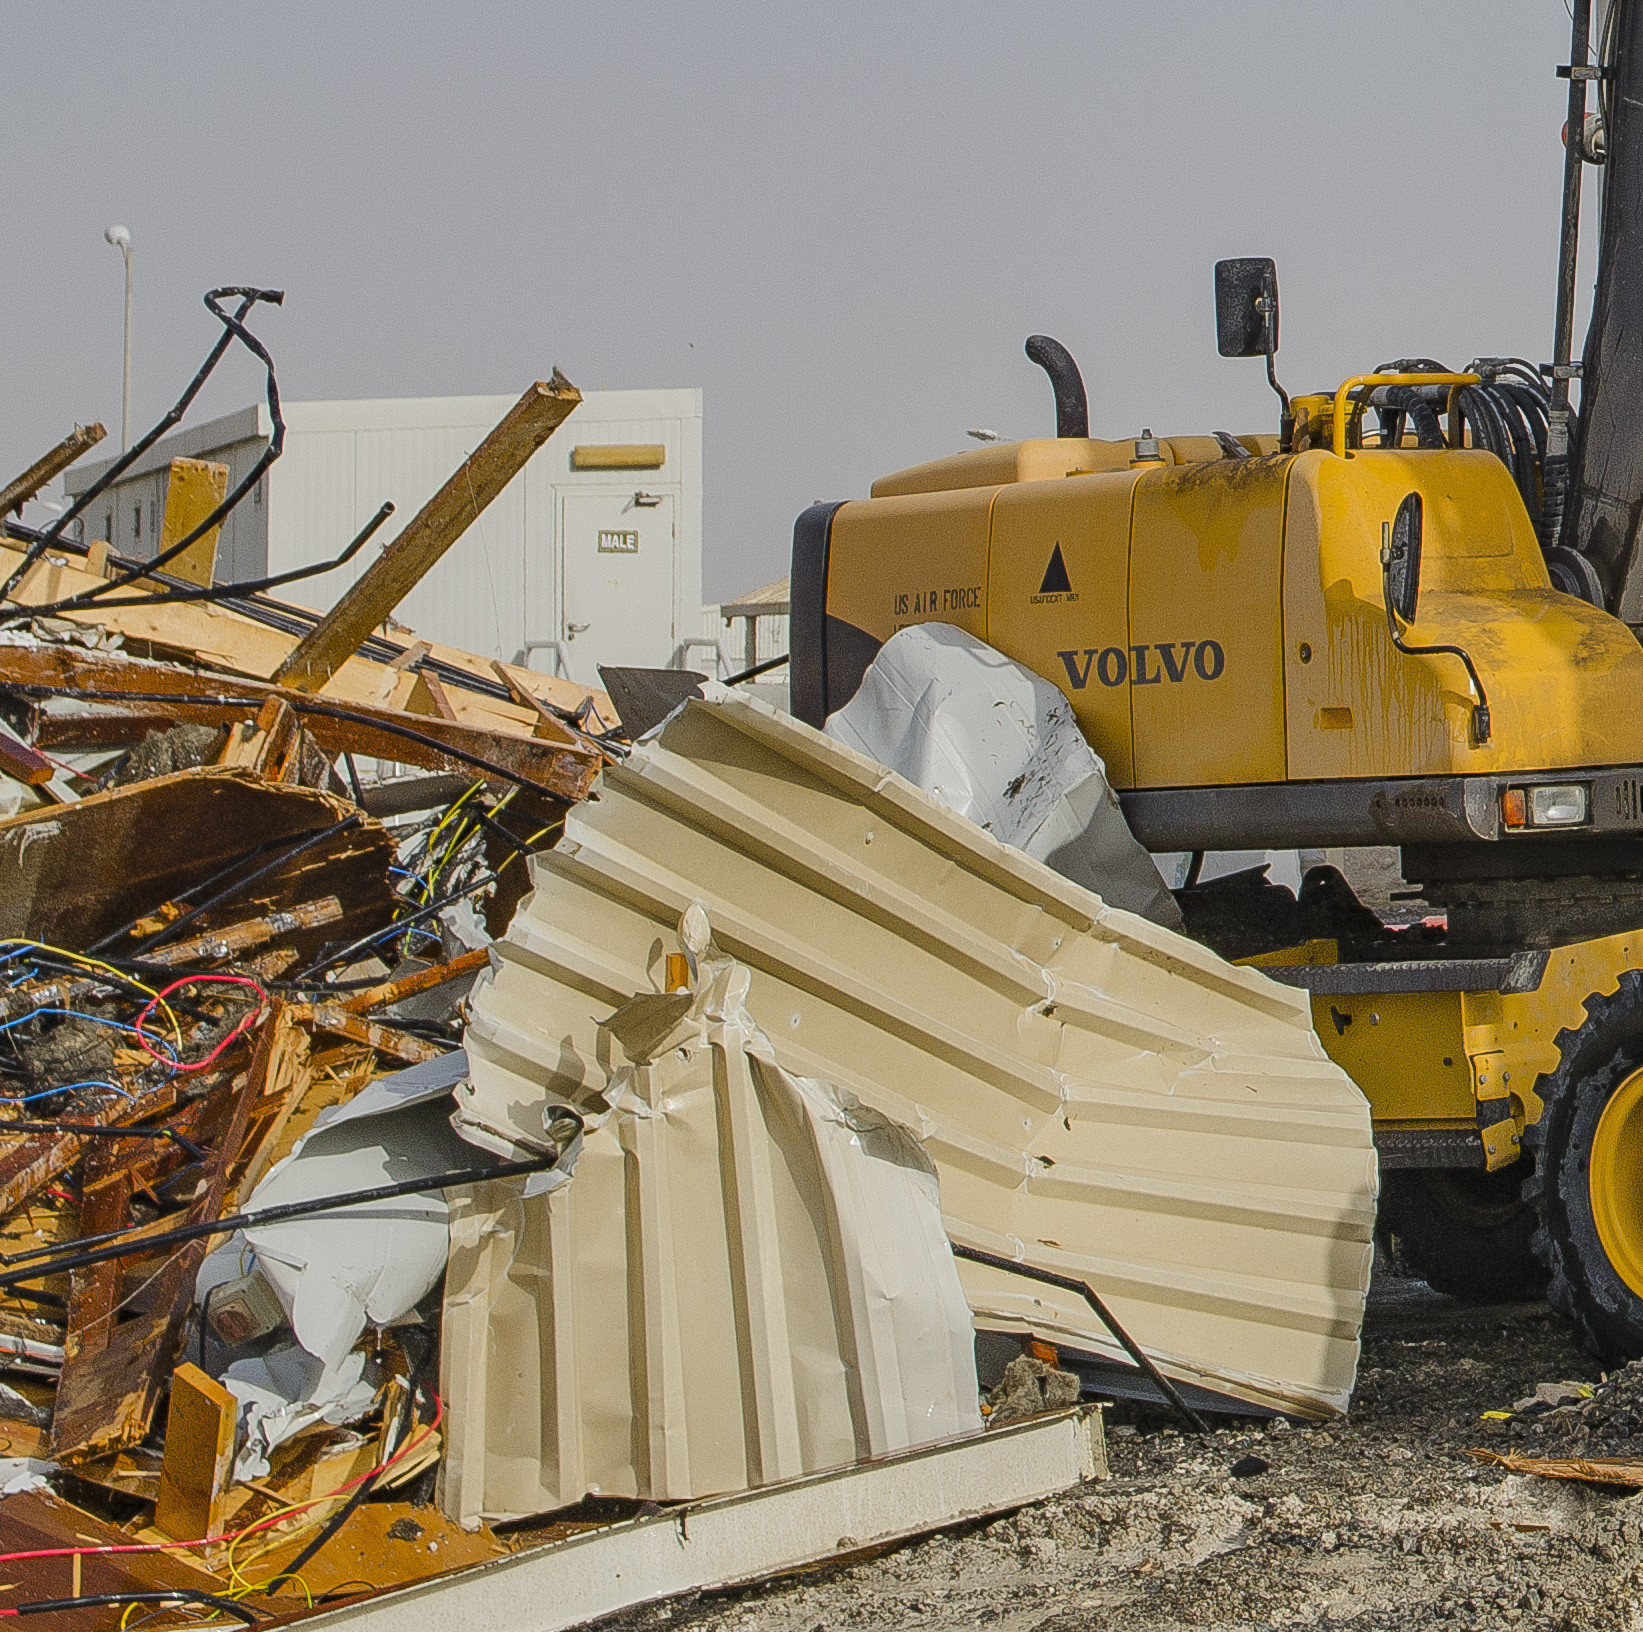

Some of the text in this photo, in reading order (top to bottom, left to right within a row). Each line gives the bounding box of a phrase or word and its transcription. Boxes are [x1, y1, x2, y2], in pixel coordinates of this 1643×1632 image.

[601, 533, 636, 550] MALE
[894, 585, 982, 616] US AIR FORCE
[1056, 639, 1225, 690] VOLVO
